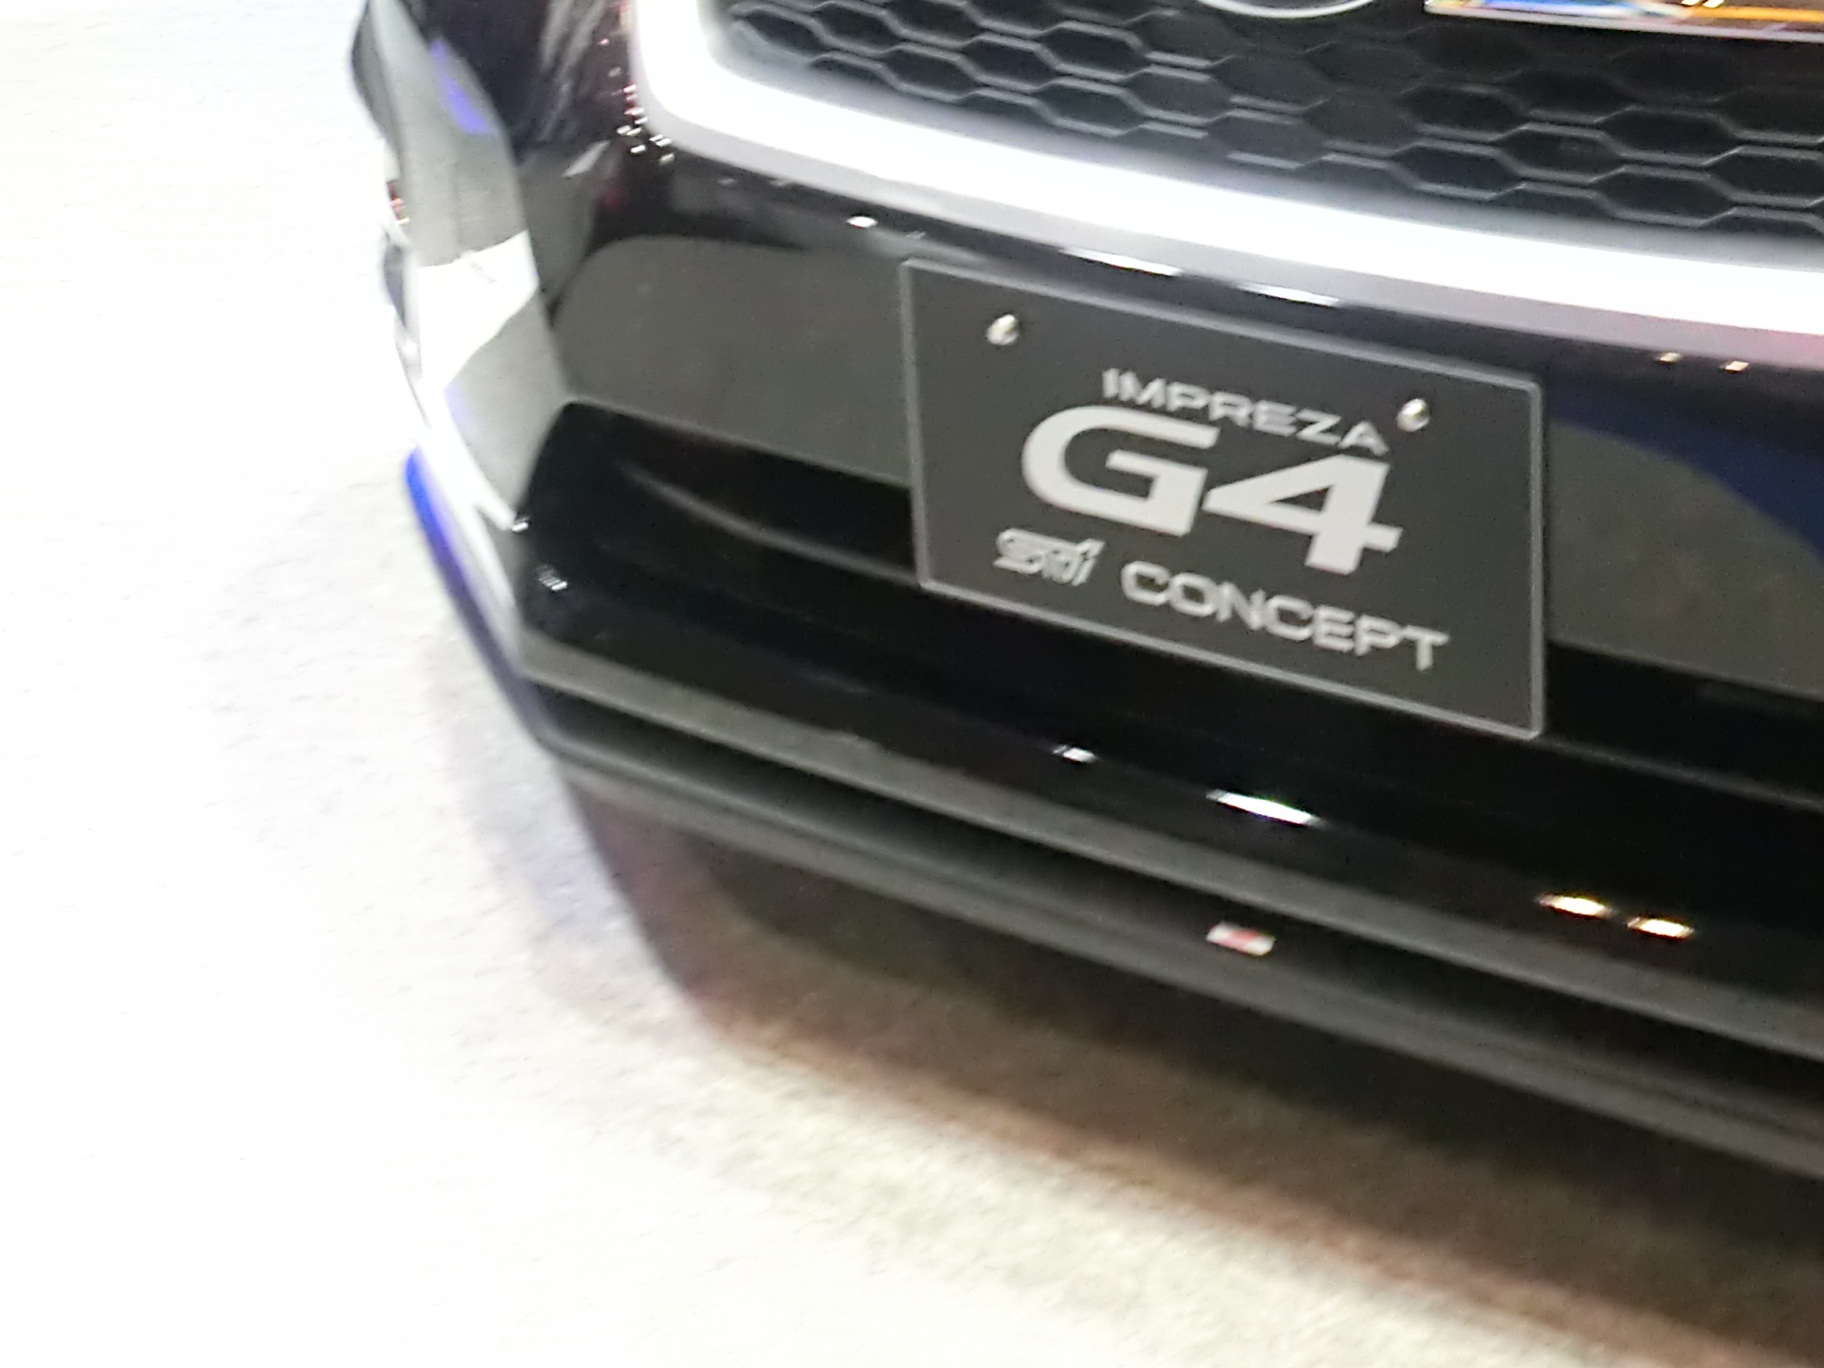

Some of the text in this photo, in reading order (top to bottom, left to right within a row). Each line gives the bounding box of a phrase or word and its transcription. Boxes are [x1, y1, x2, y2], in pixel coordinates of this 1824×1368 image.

[1102, 367, 1389, 455] IMPREZA
[1022, 404, 1403, 575] G4
[1120, 560, 1449, 671] CONCEPT
